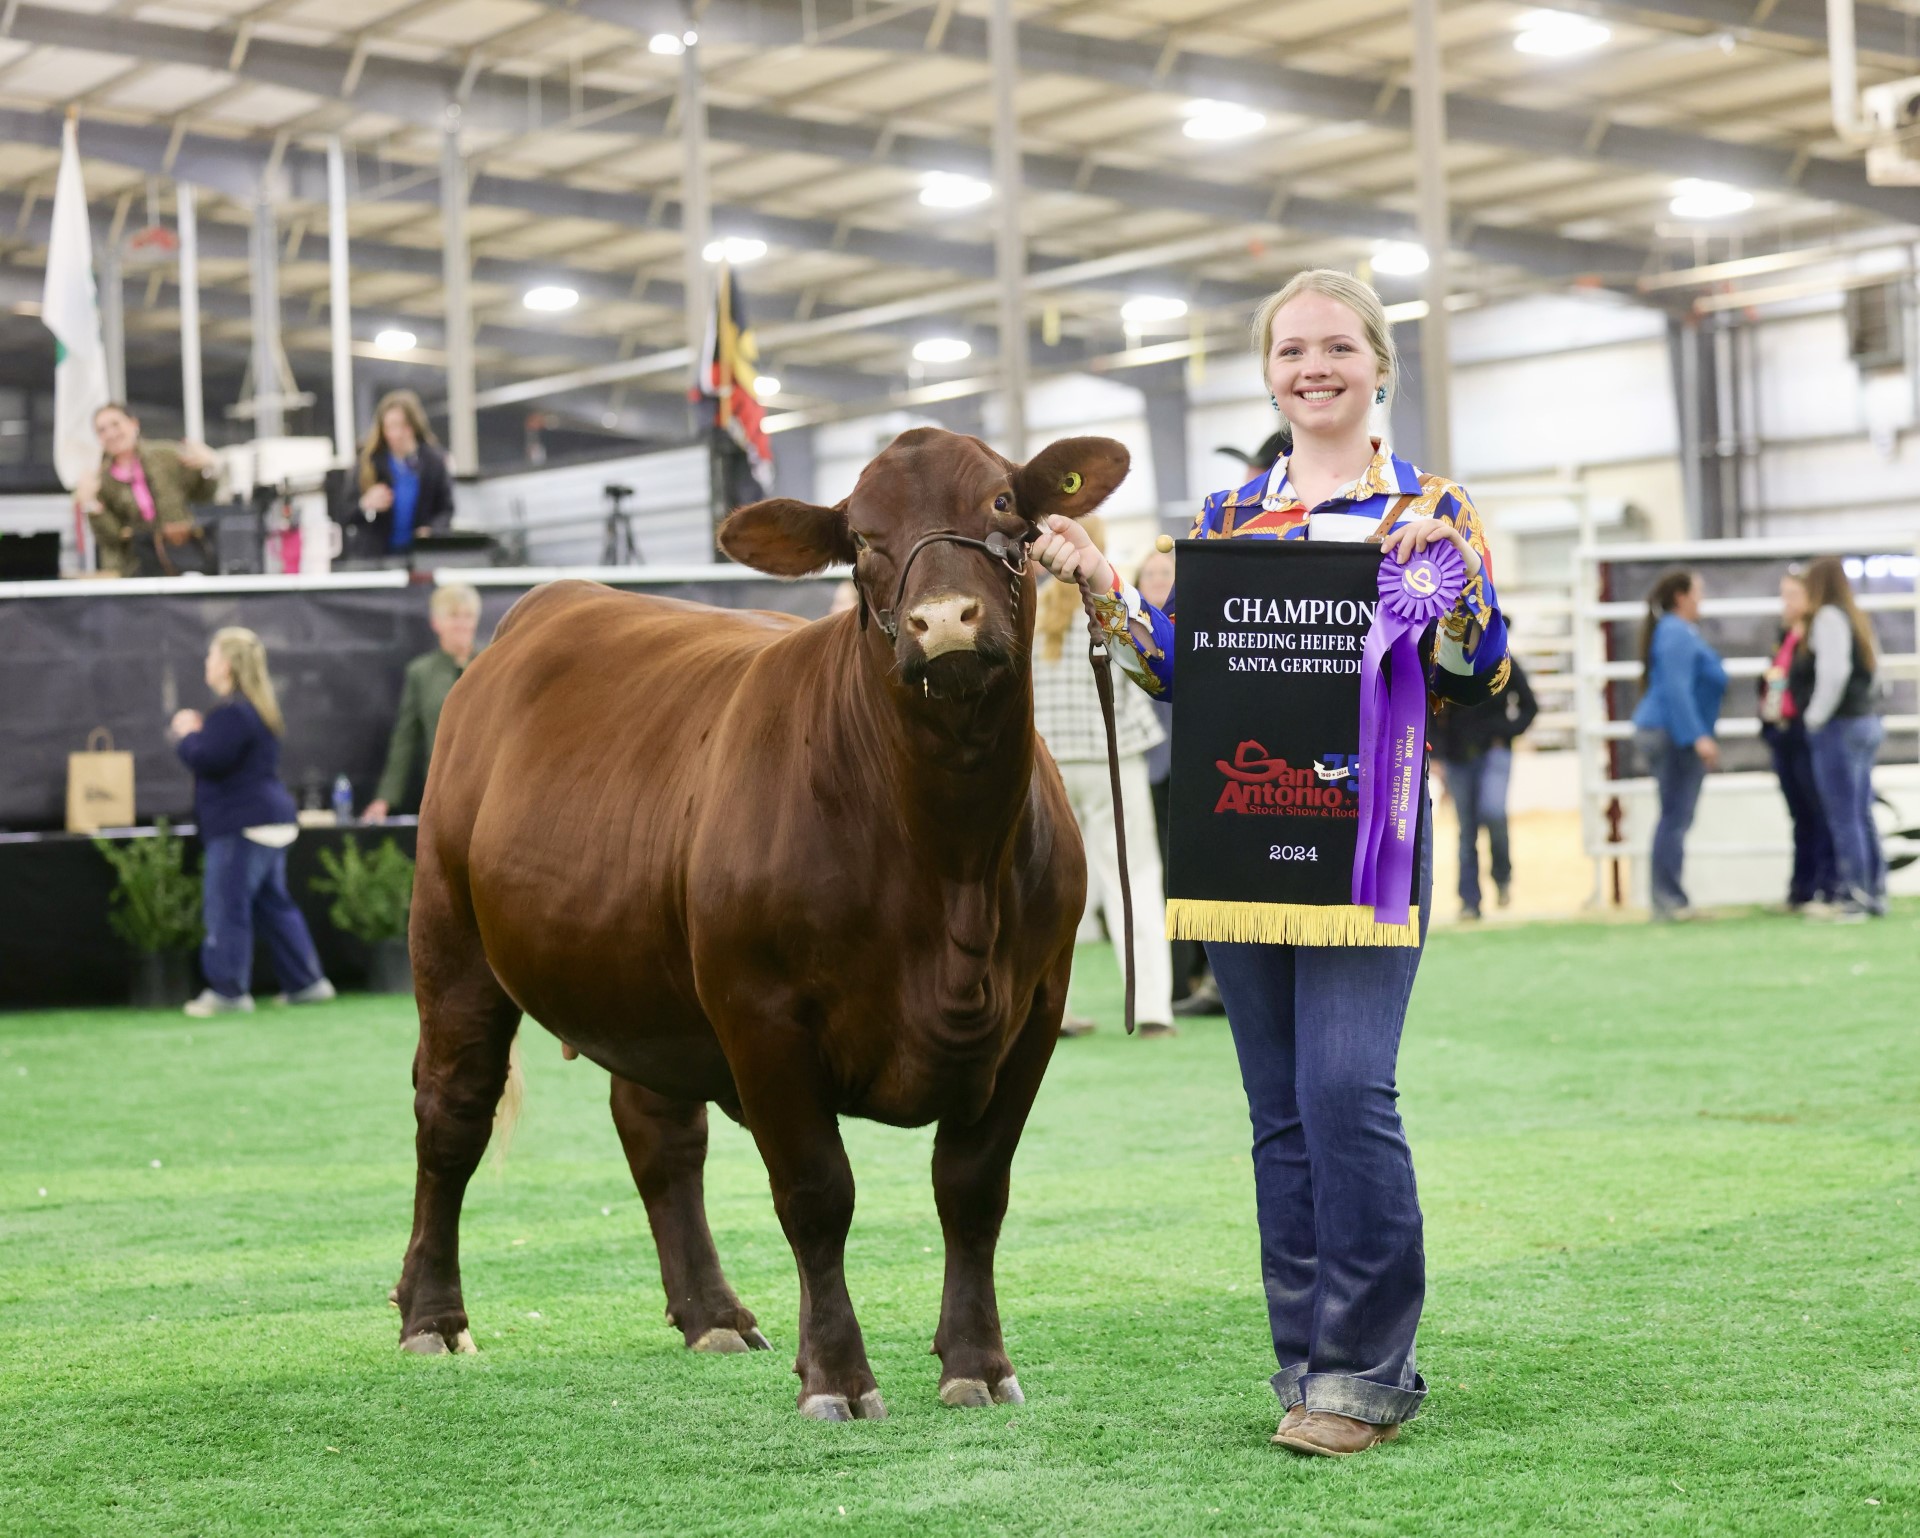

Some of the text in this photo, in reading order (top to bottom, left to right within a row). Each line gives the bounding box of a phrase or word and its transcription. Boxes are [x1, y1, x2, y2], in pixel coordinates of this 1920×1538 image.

[1223, 597, 1377, 625] CHAMPION
[1192, 631, 1214, 652] JR.
[1217, 632, 1297, 650] BREEDING
[1300, 634, 1357, 651] HEIFER
[1228, 656, 1362, 674] SANTA GERTRUDI
[1215, 739, 1315, 787] San
[1389, 738, 1404, 827] SANTA GERTRUDIS
[1397, 724, 1415, 842] JUNIOR BREEDING BEEF
[1213, 781, 1343, 814] Antonio
[1249, 804, 1360, 818] Stock Show & Rod
[1269, 844, 1319, 862] 2024
